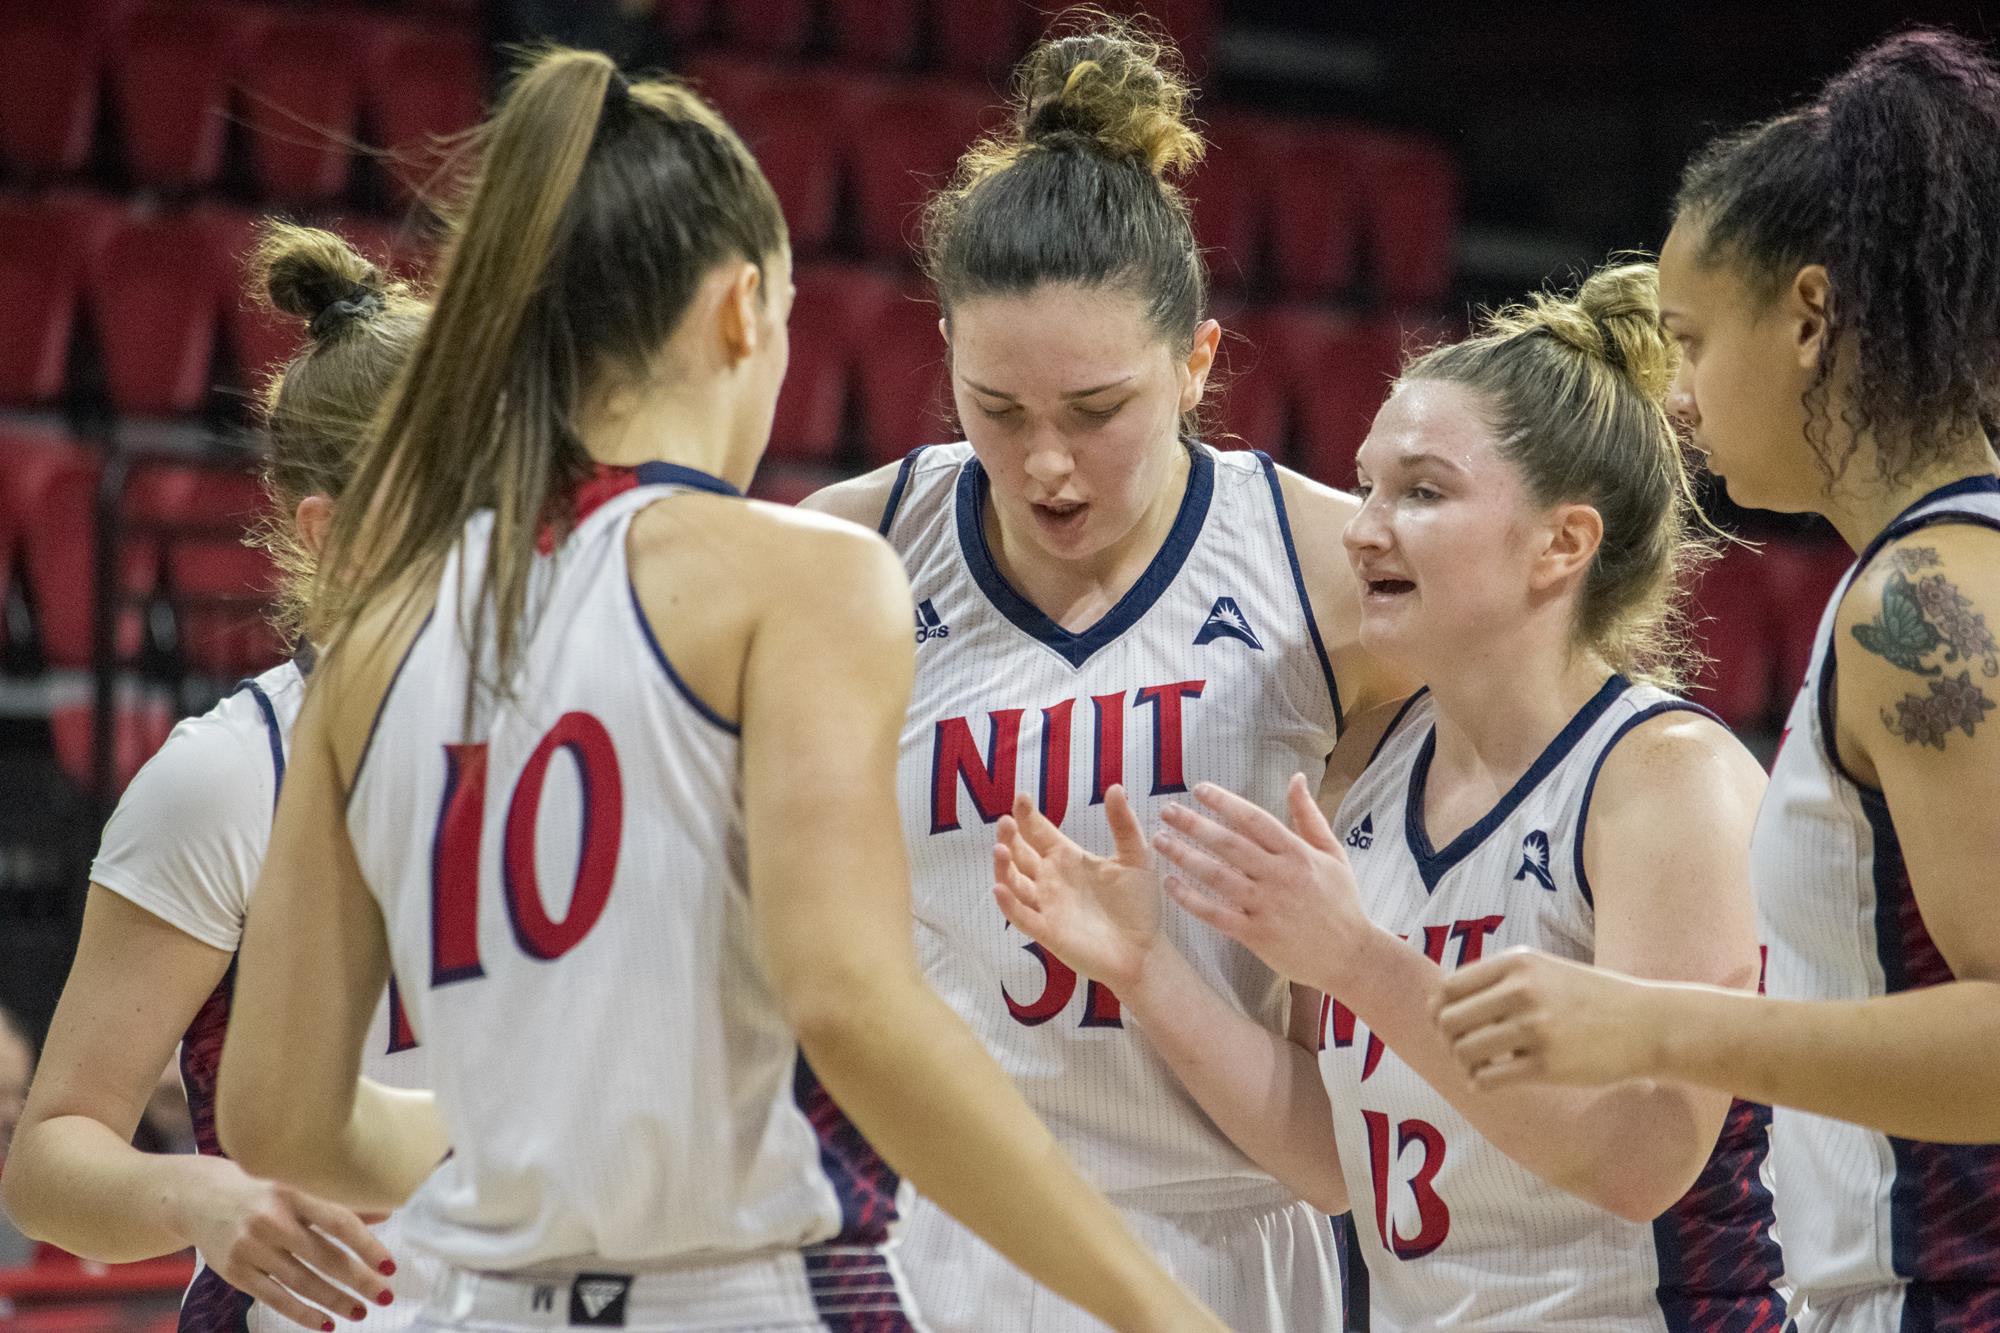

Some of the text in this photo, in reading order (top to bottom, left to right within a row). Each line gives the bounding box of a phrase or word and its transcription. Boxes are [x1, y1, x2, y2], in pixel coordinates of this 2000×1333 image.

[929, 679, 1206, 836] NJIT
[428, 710, 624, 990] 10
[1361, 1108, 1450, 1262] 13
